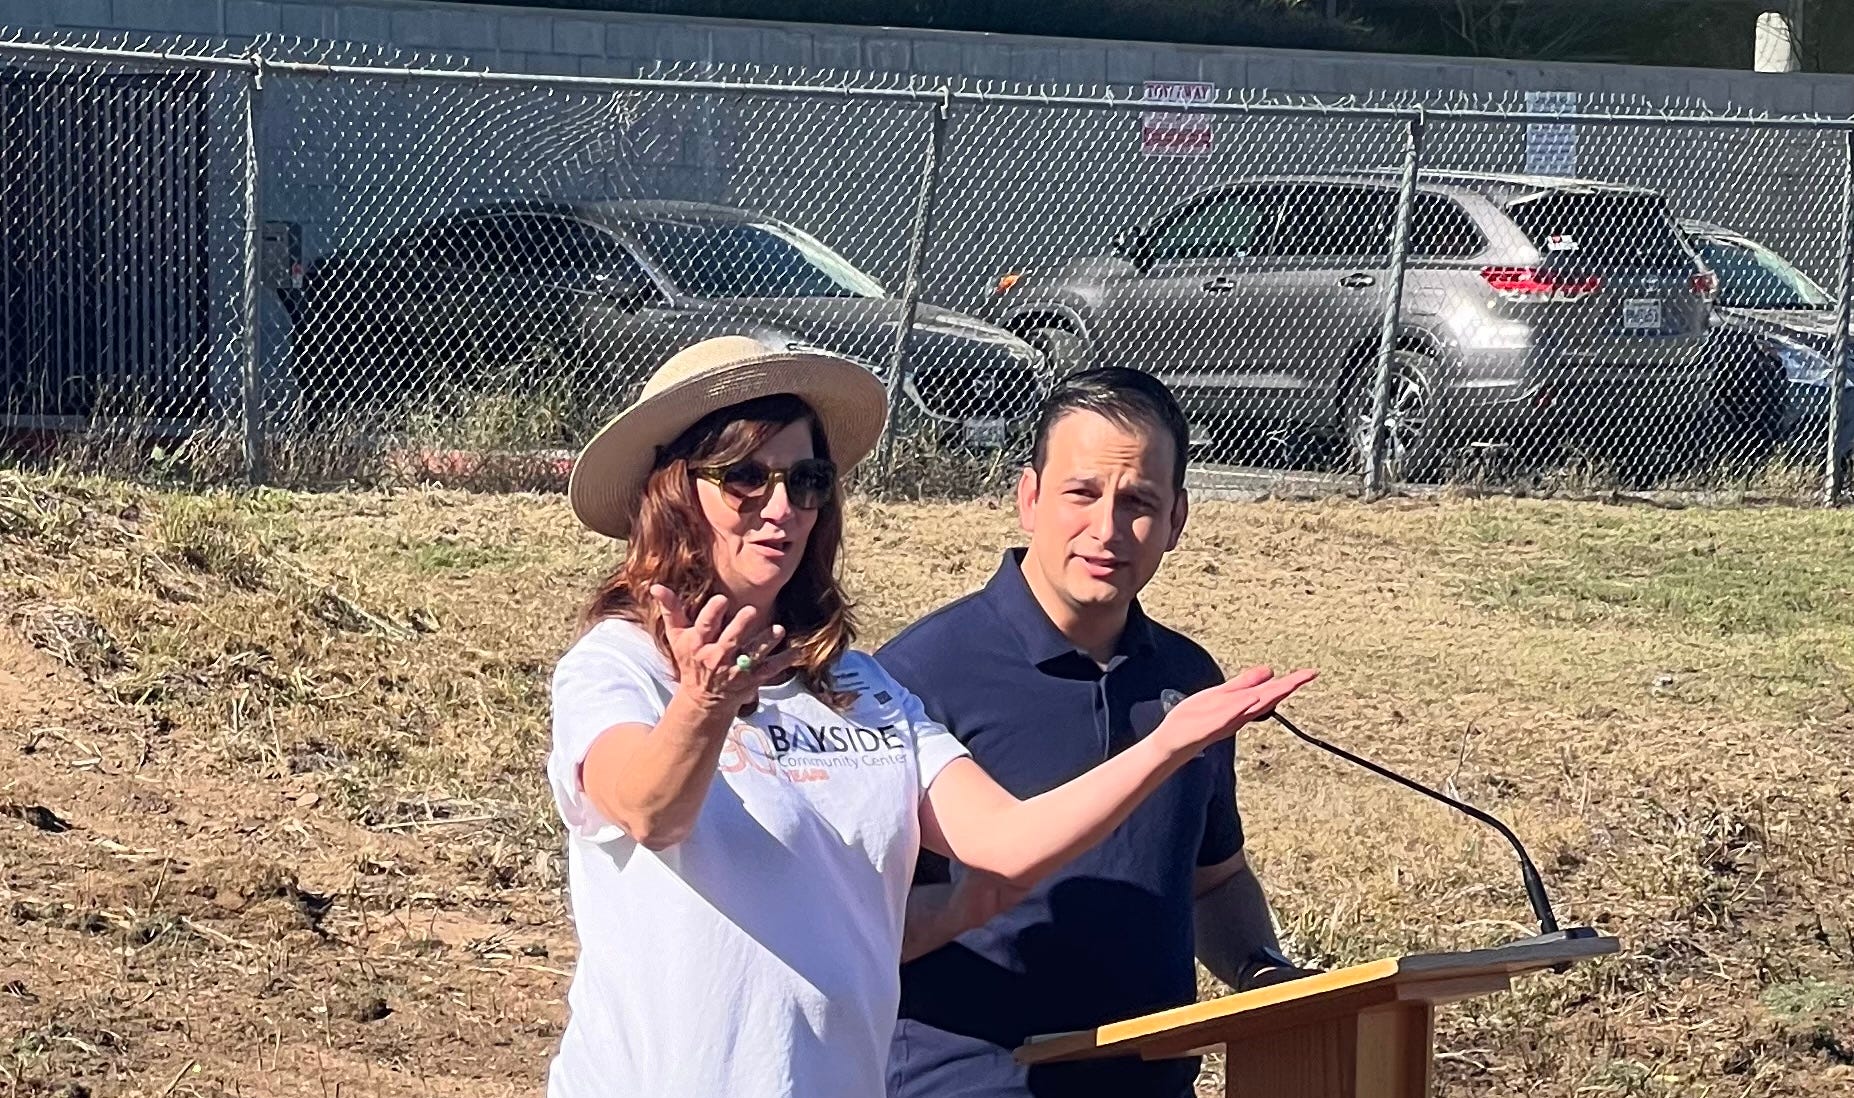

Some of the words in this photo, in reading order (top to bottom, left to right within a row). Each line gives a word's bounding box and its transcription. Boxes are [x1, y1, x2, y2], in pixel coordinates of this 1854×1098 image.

[767, 724, 905, 753] BAYSIDE
[777, 753, 859, 769] Community
[861, 752, 907, 767] Center
